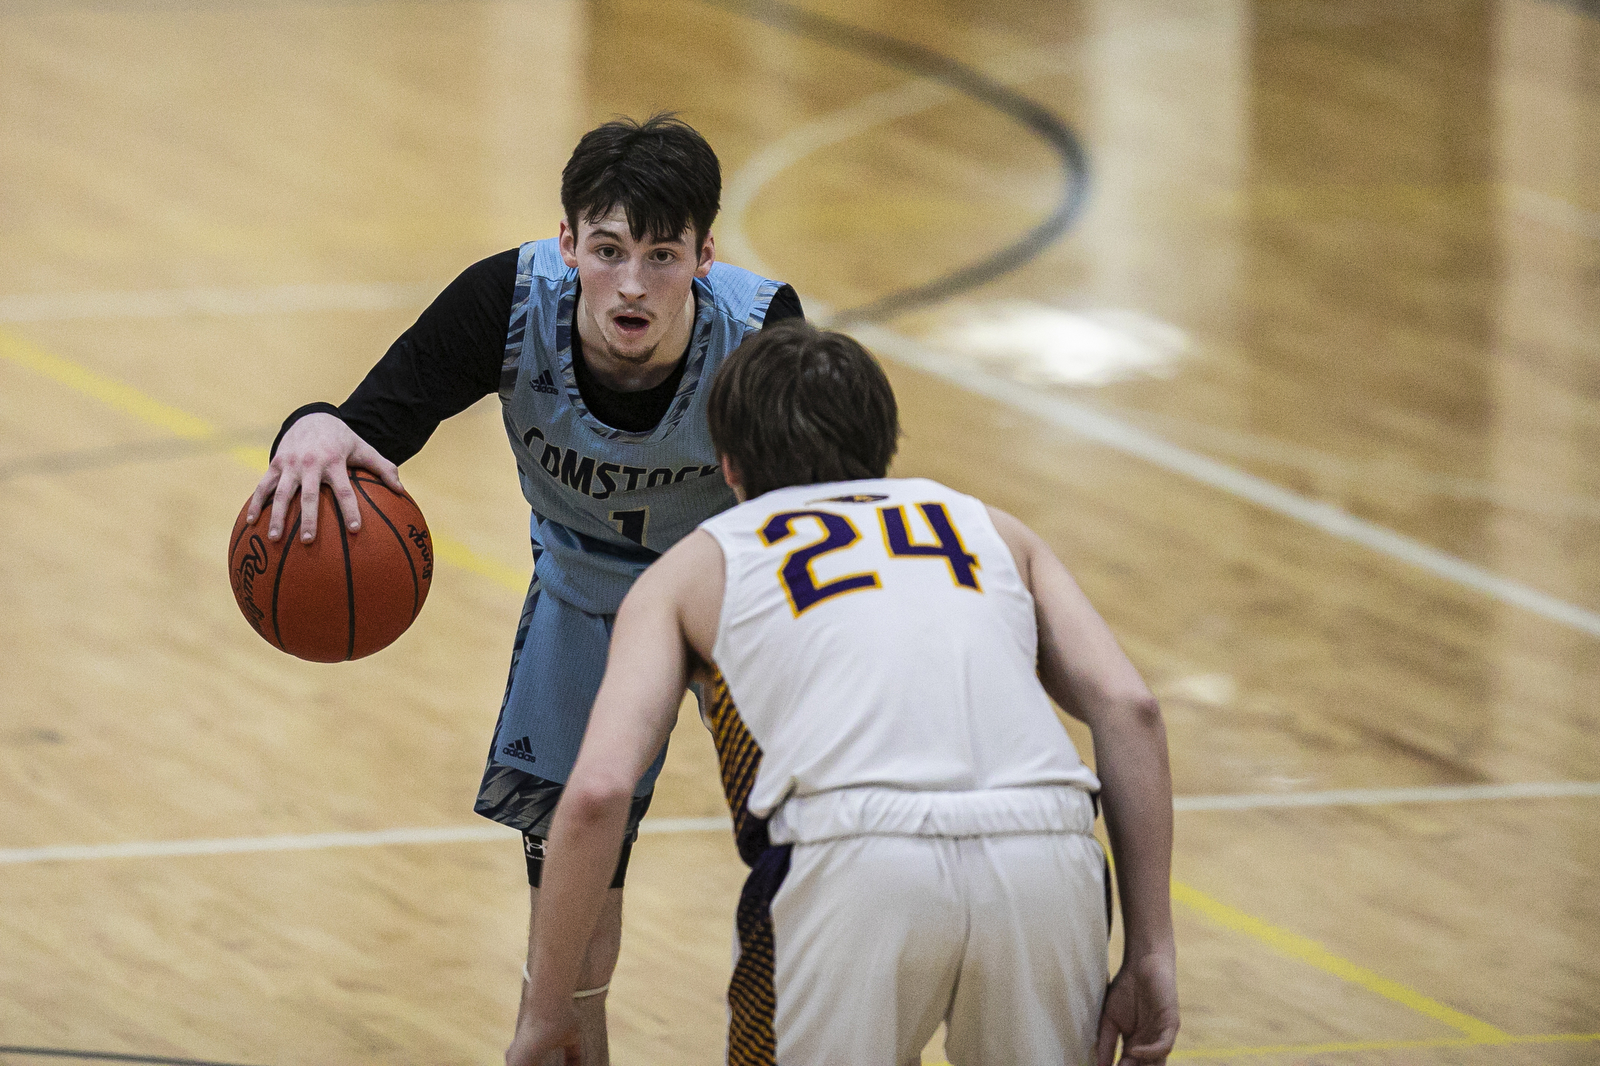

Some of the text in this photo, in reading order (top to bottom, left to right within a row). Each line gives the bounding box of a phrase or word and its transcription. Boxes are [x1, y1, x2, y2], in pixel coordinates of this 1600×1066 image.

[608, 505, 650, 547] 1
[755, 502, 984, 620] 24
[502, 746, 536, 763] adidas
